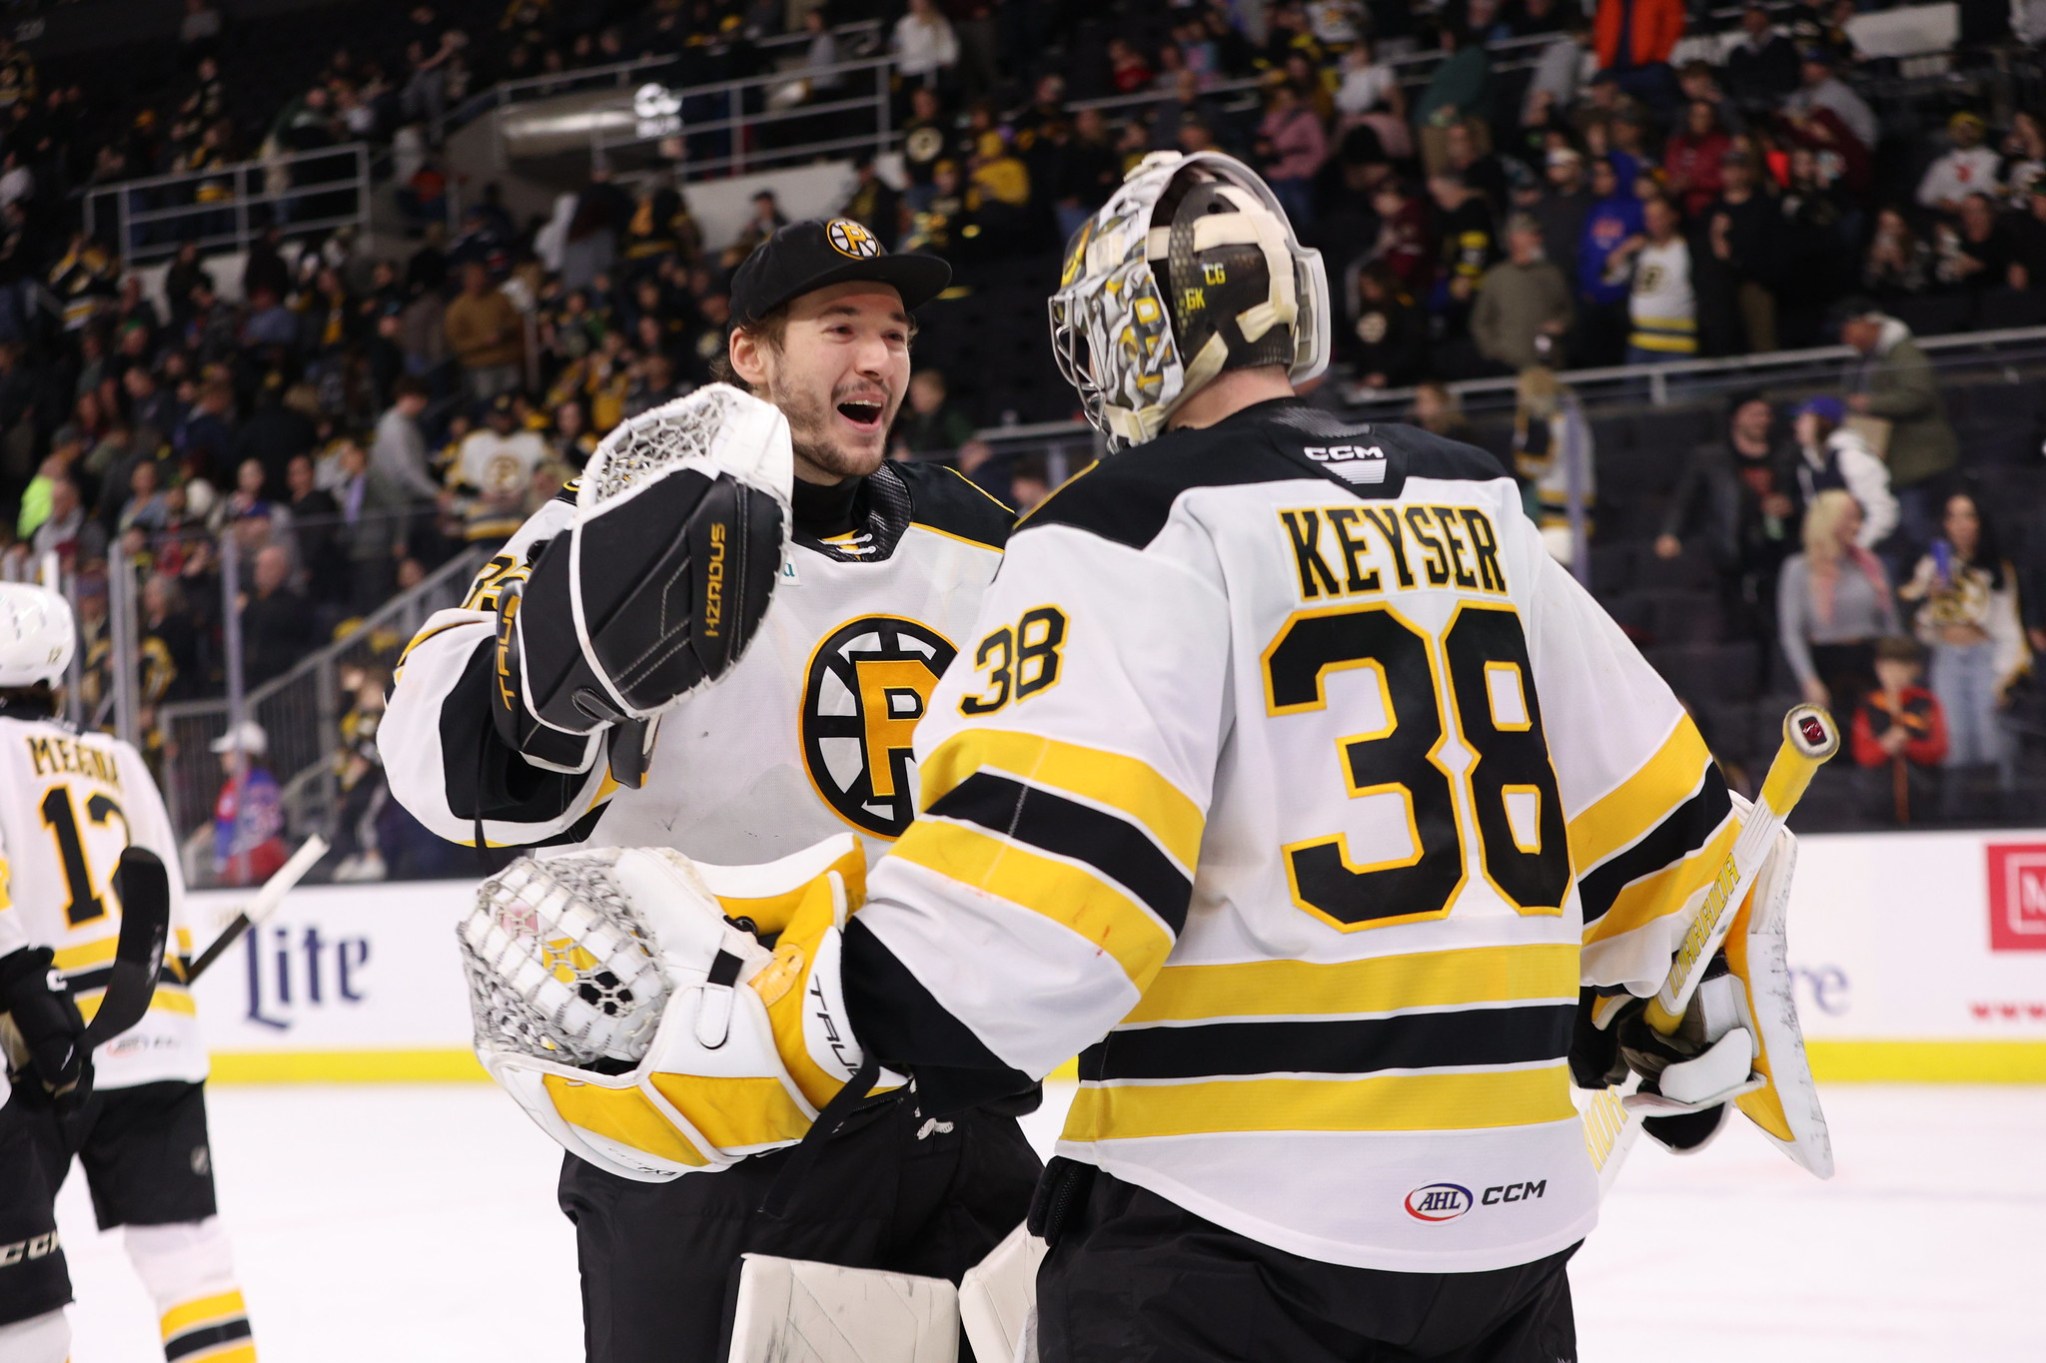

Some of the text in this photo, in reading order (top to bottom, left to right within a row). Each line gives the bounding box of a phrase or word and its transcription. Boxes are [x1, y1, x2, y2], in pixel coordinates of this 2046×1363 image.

[1304, 446, 1384, 461] CCM
[1279, 505, 1510, 602] KEYSER
[957, 604, 1069, 718] 38
[1260, 600, 1573, 933] 38
[246, 922, 370, 1029] Lite
[1667, 851, 1742, 1001] WARRIOR
[1416, 1190, 1462, 1212] AHL
[1481, 1179, 1548, 1206] CCM
